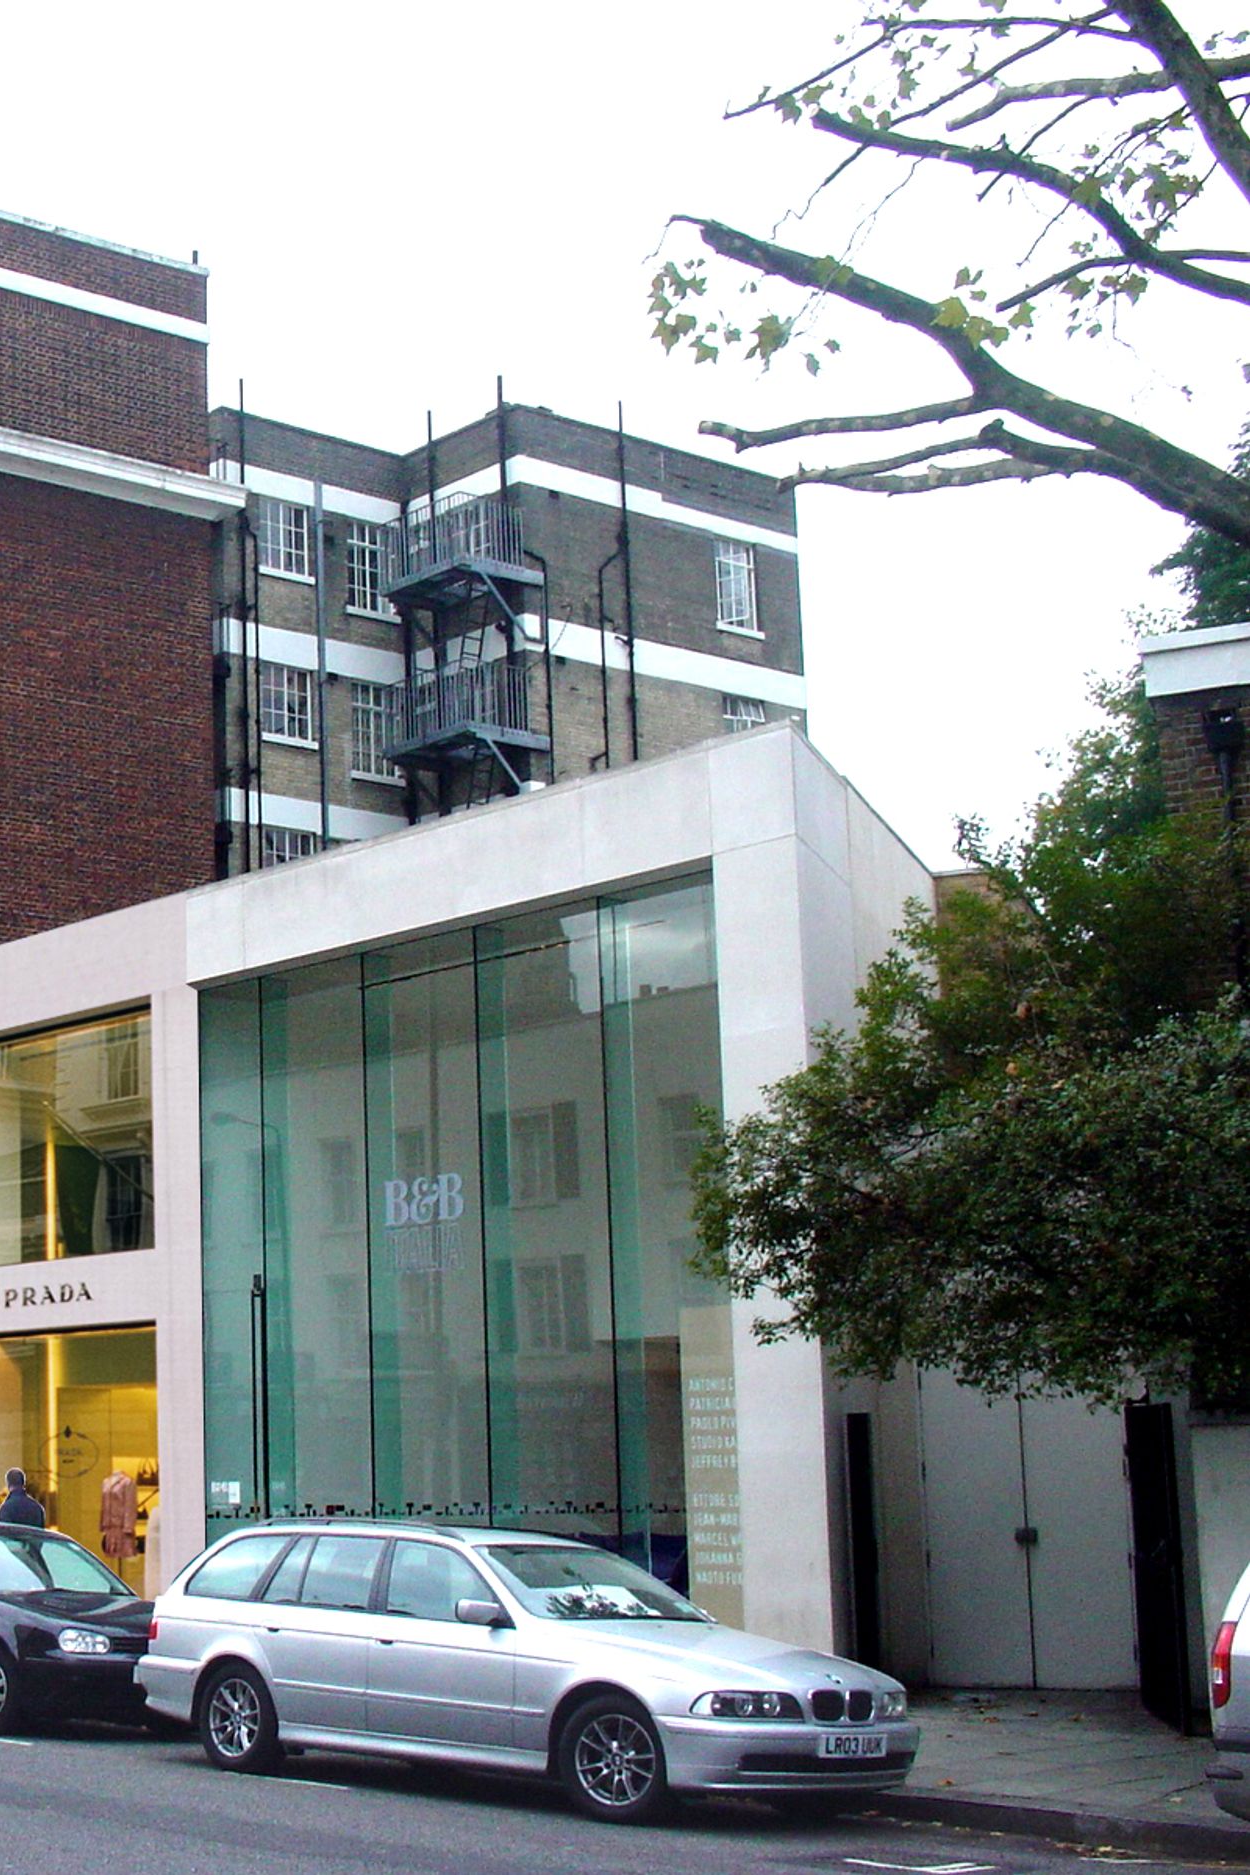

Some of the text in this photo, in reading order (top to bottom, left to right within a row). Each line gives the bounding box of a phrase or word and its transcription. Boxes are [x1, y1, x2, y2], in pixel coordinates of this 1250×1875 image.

[383, 1172, 464, 1227] B&B
[4, 1282, 94, 1309] PRADA
[825, 1736, 860, 1755] LR03
